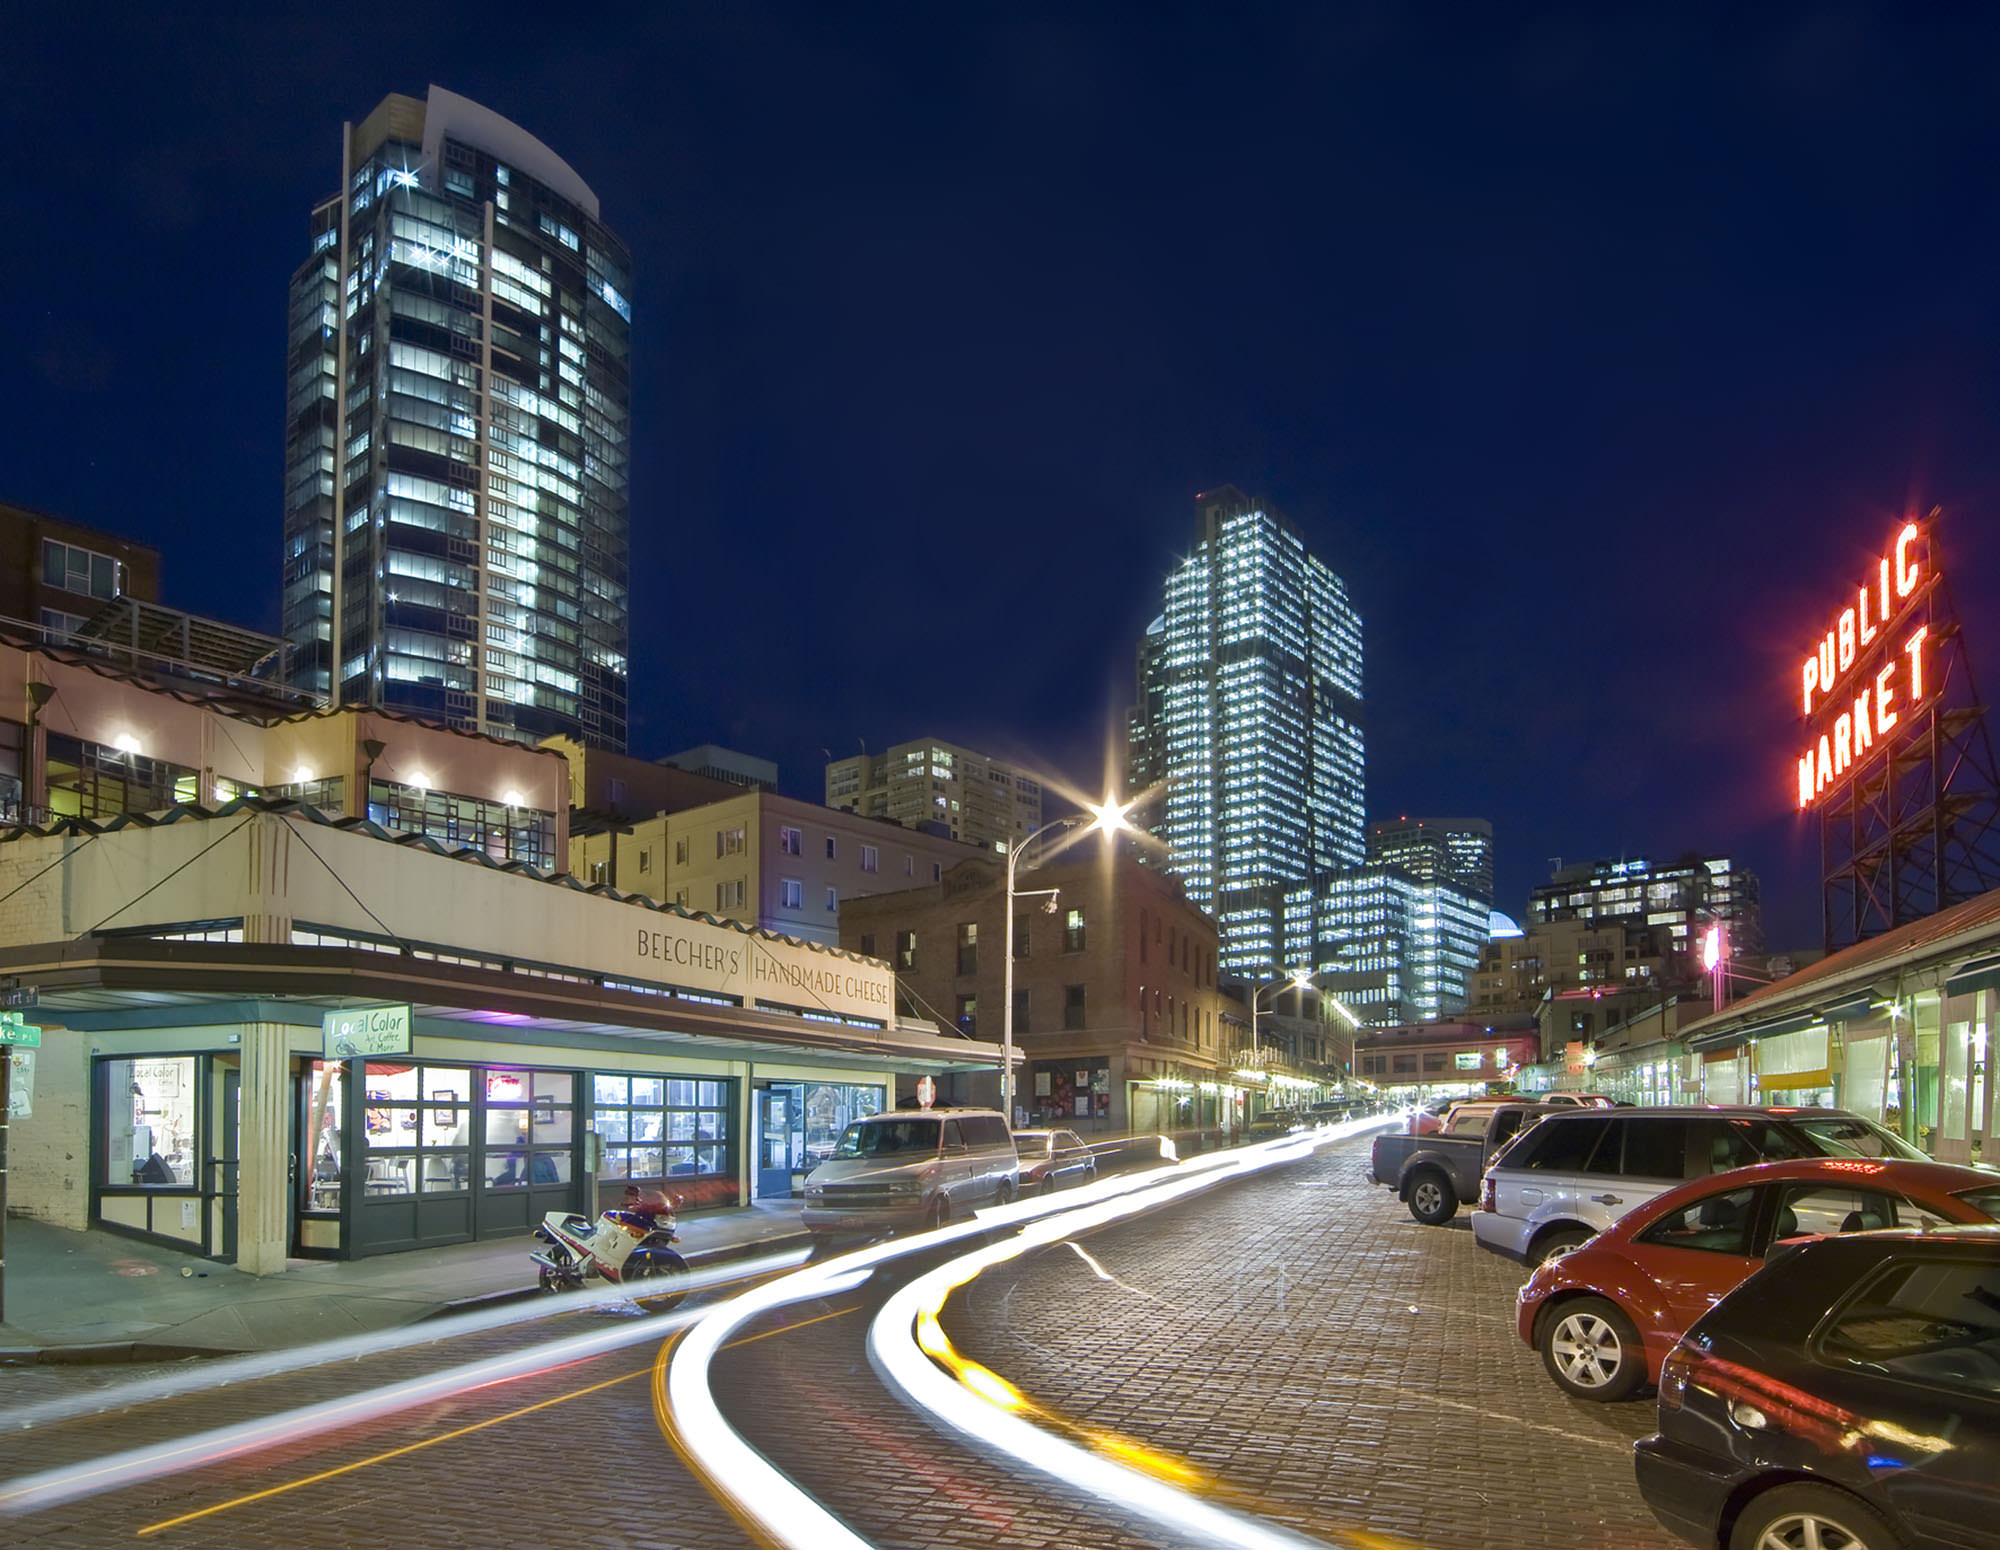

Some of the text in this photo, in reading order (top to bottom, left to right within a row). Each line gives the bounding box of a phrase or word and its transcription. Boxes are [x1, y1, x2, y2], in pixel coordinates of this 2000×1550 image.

[1802, 522, 1919, 715] PUBLIC
[1798, 624, 1929, 809] MARKET
[330, 1012, 404, 1037] Local Color
[637, 929, 889, 1005] BEECHER'S HANDMADE CHEESE
